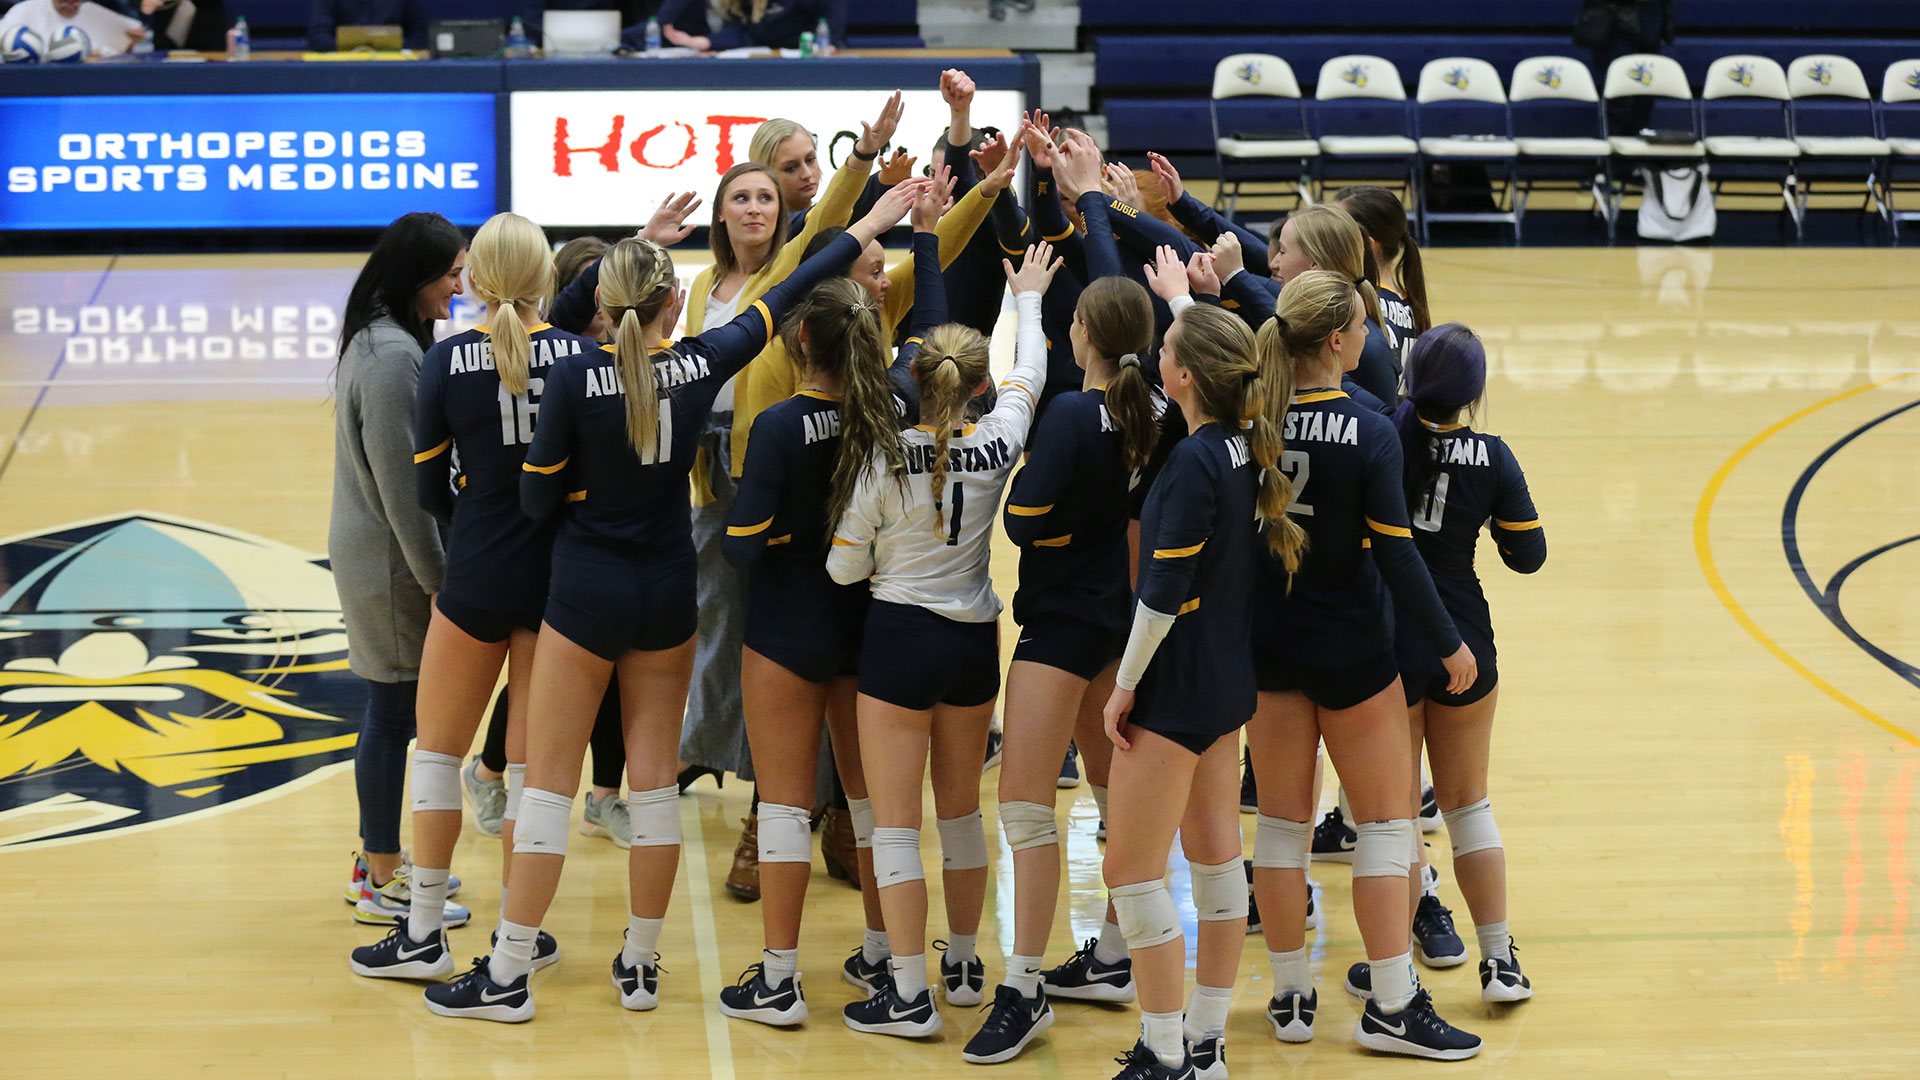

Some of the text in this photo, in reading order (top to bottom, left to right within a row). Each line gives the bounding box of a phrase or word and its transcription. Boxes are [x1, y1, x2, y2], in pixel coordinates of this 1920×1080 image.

[59, 131, 426, 160] ORTHOPEDICS
[8, 162, 479, 193] SPORTS MEDICINE
[1110, 199, 1139, 219] AUGIE
[450, 339, 582, 376] AUGTANA
[586, 354, 711, 398] AUTANA
[1284, 411, 1359, 446] STANA
[897, 436, 1009, 475] UGSTANA
